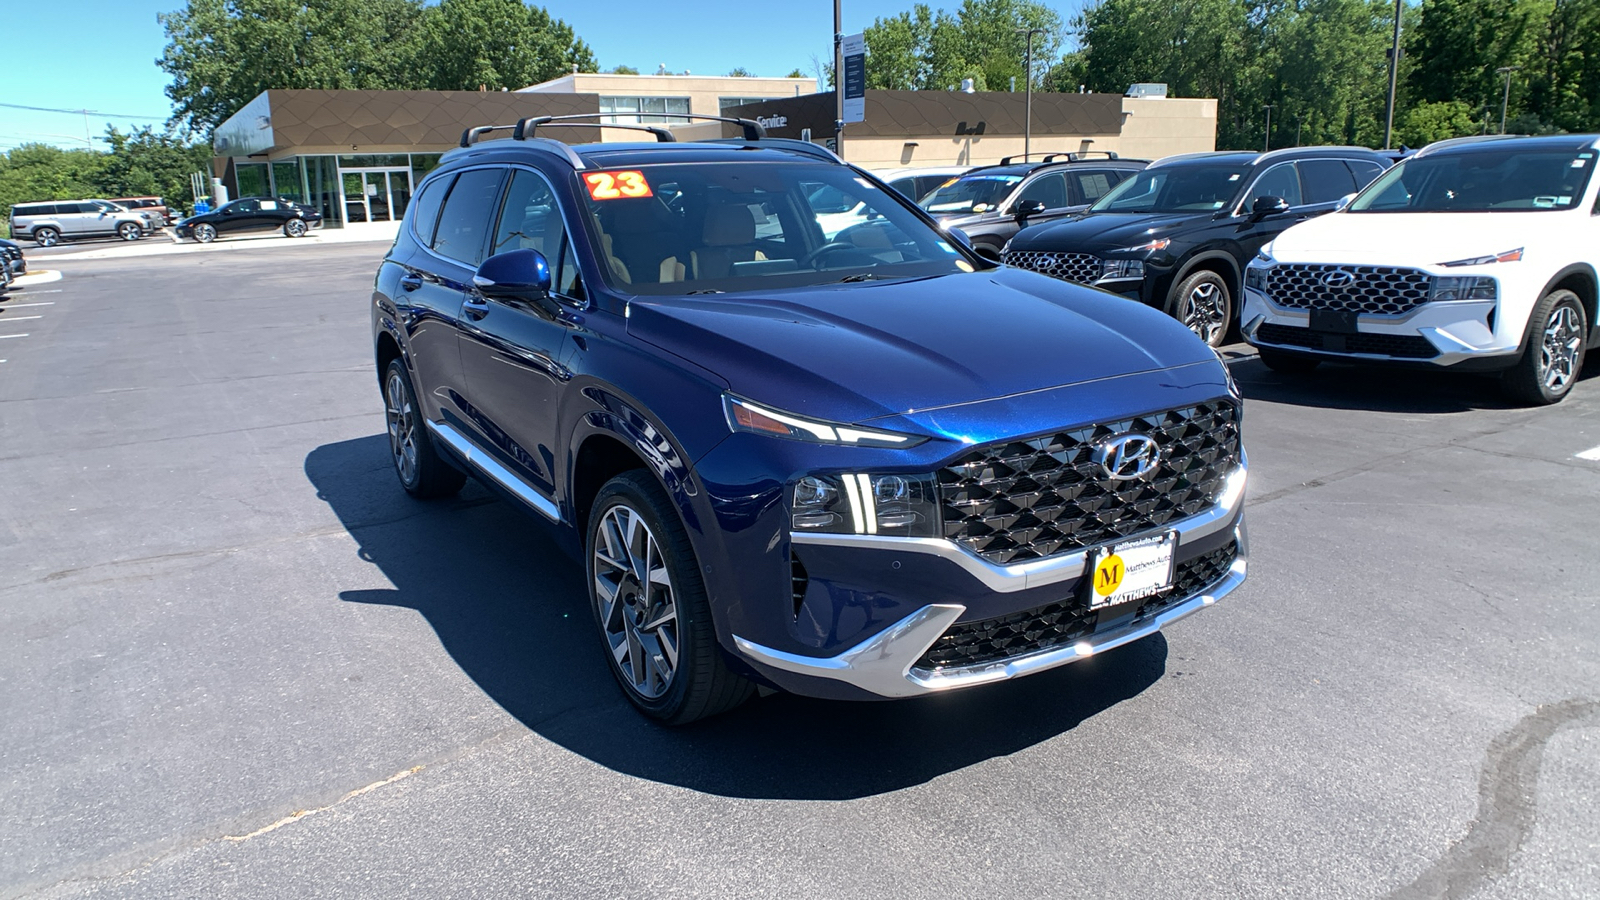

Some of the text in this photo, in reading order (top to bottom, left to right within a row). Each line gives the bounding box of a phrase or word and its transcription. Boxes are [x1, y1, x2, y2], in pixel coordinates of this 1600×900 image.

[587, 171, 648, 198] 23
[1125, 560, 1156, 574] Matthews
[1156, 554, 1172, 564] Auto
[1098, 564, 1120, 589] M
[1109, 585, 1158, 606] MATTHEWS
